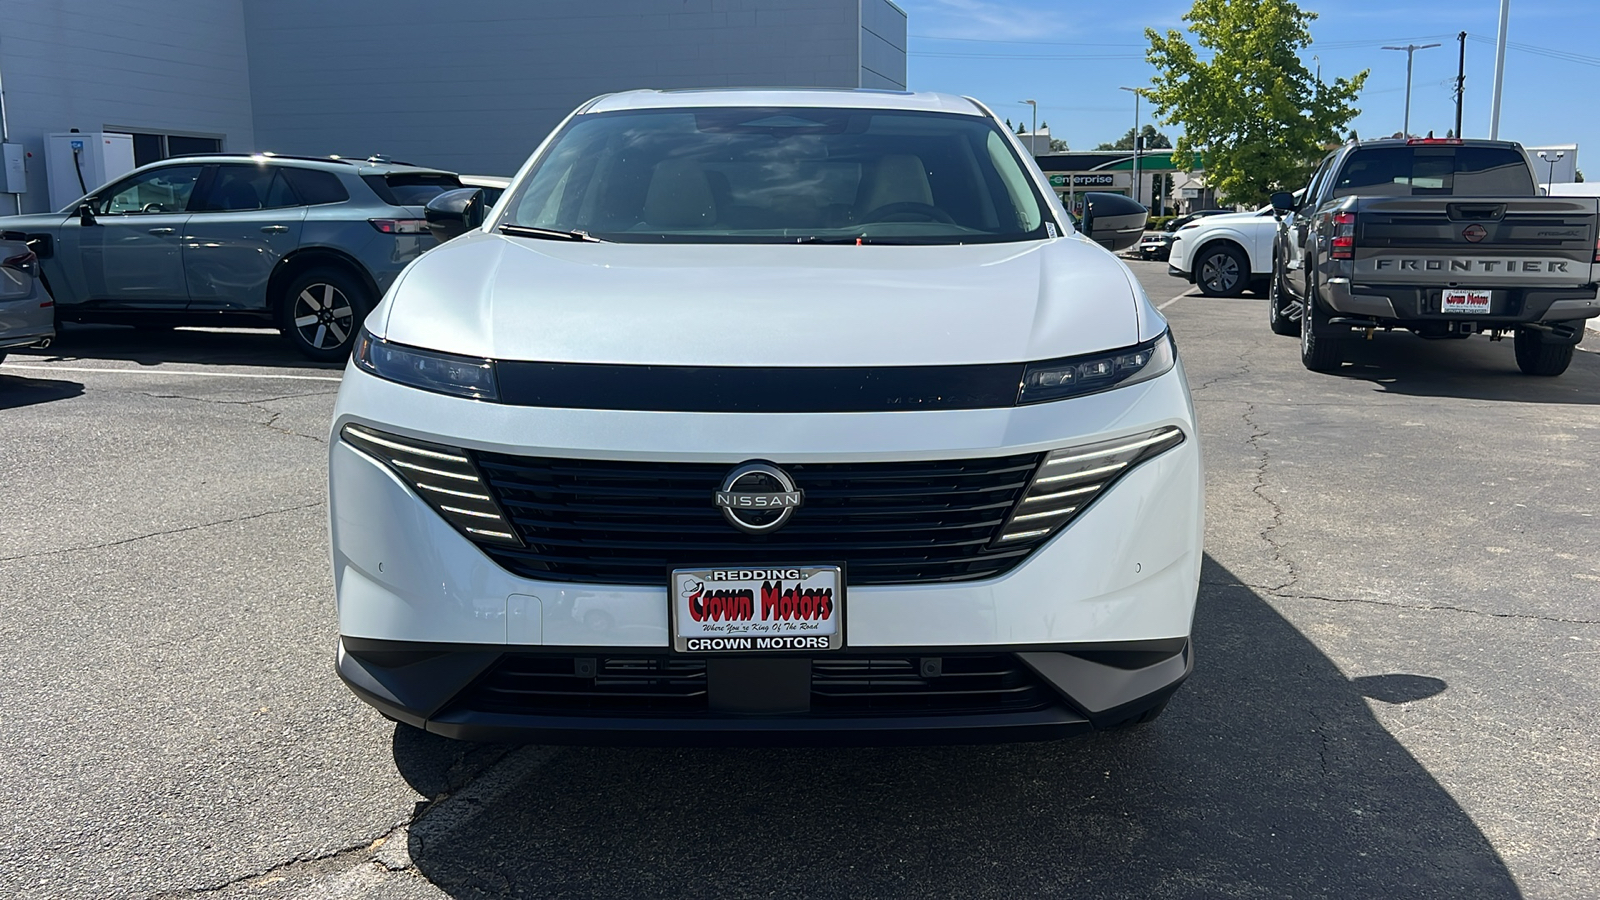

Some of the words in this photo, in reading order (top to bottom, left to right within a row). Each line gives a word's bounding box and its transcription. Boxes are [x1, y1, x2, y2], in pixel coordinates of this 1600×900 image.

[1053, 174, 1113, 185] enerprise
[1374, 258, 1569, 273] FRONTIER
[717, 494, 798, 507] NISSAN
[713, 570, 800, 581] REDDING
[688, 582, 754, 622] Crown
[760, 581, 833, 622] Motors
[702, 624, 724, 632] Where
[751, 623, 769, 633] King
[771, 623, 782, 632] Of
[784, 622, 797, 631] The
[799, 622, 819, 631] Road
[687, 638, 751, 650] CROWN
[756, 636, 829, 649] MOTORS
